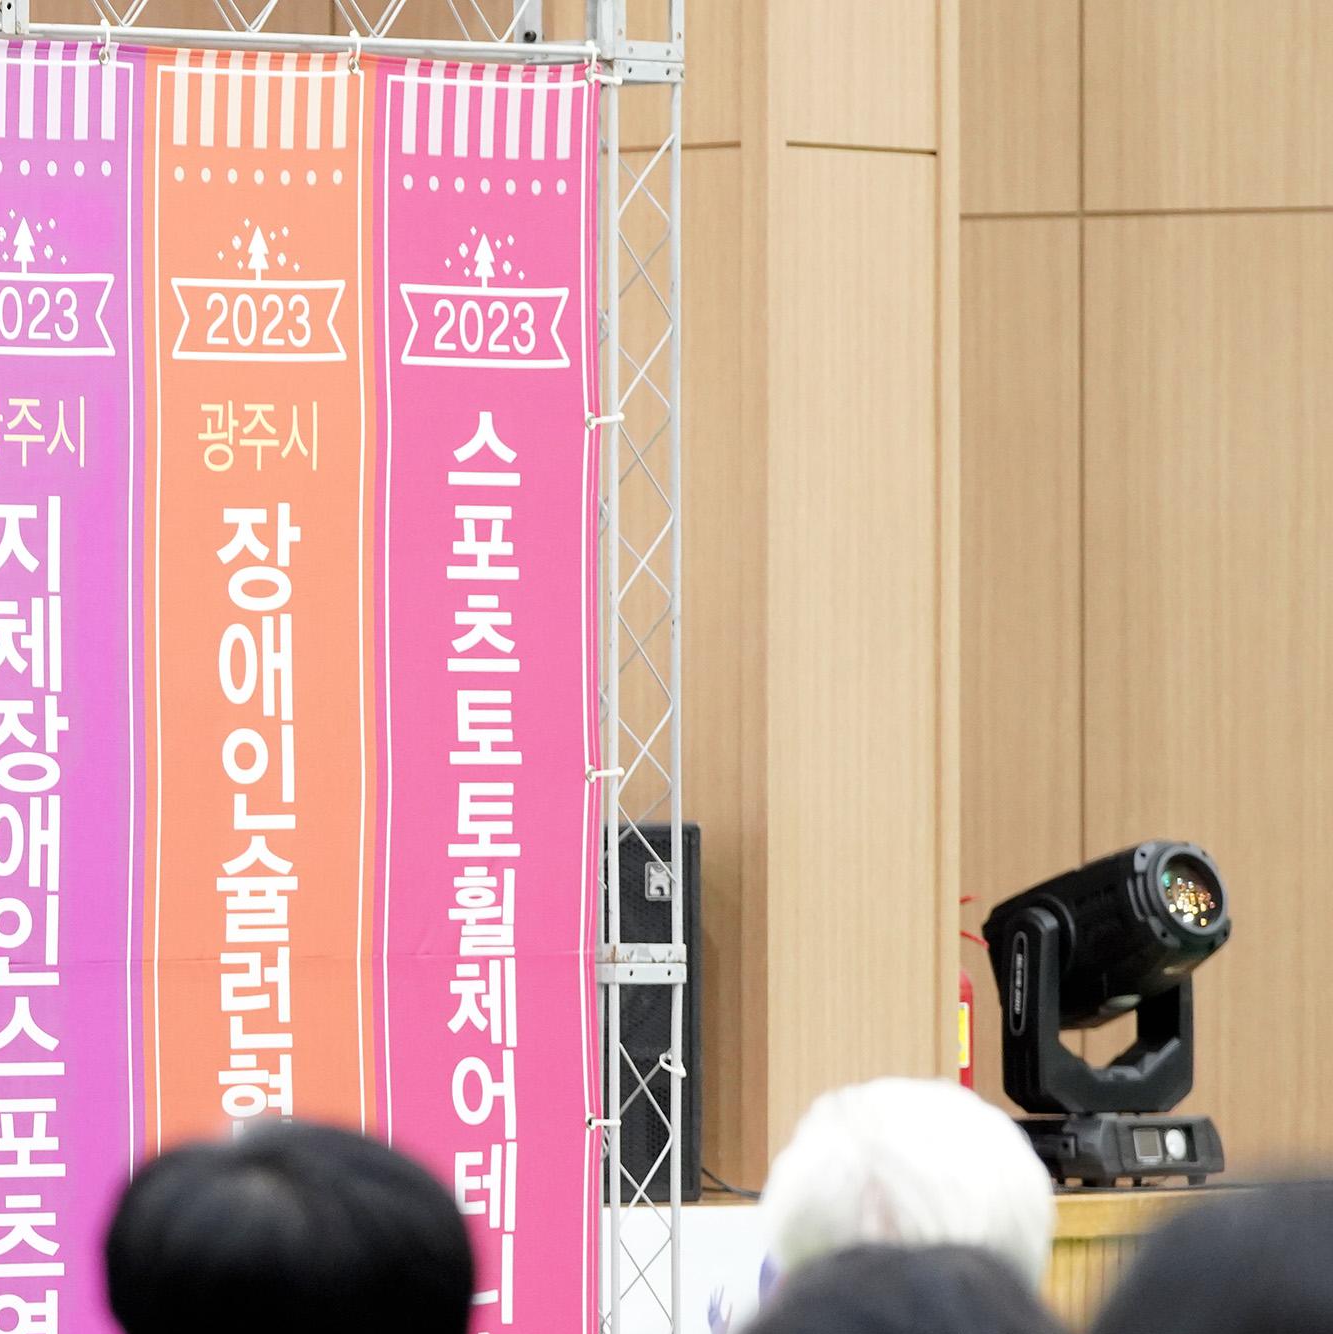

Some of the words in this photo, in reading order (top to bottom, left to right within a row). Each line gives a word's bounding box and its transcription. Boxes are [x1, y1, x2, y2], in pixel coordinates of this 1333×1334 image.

[207, 293, 311, 347] 2023
[434, 299, 535, 354] 2023
[198, 400, 317, 472] 광주시
